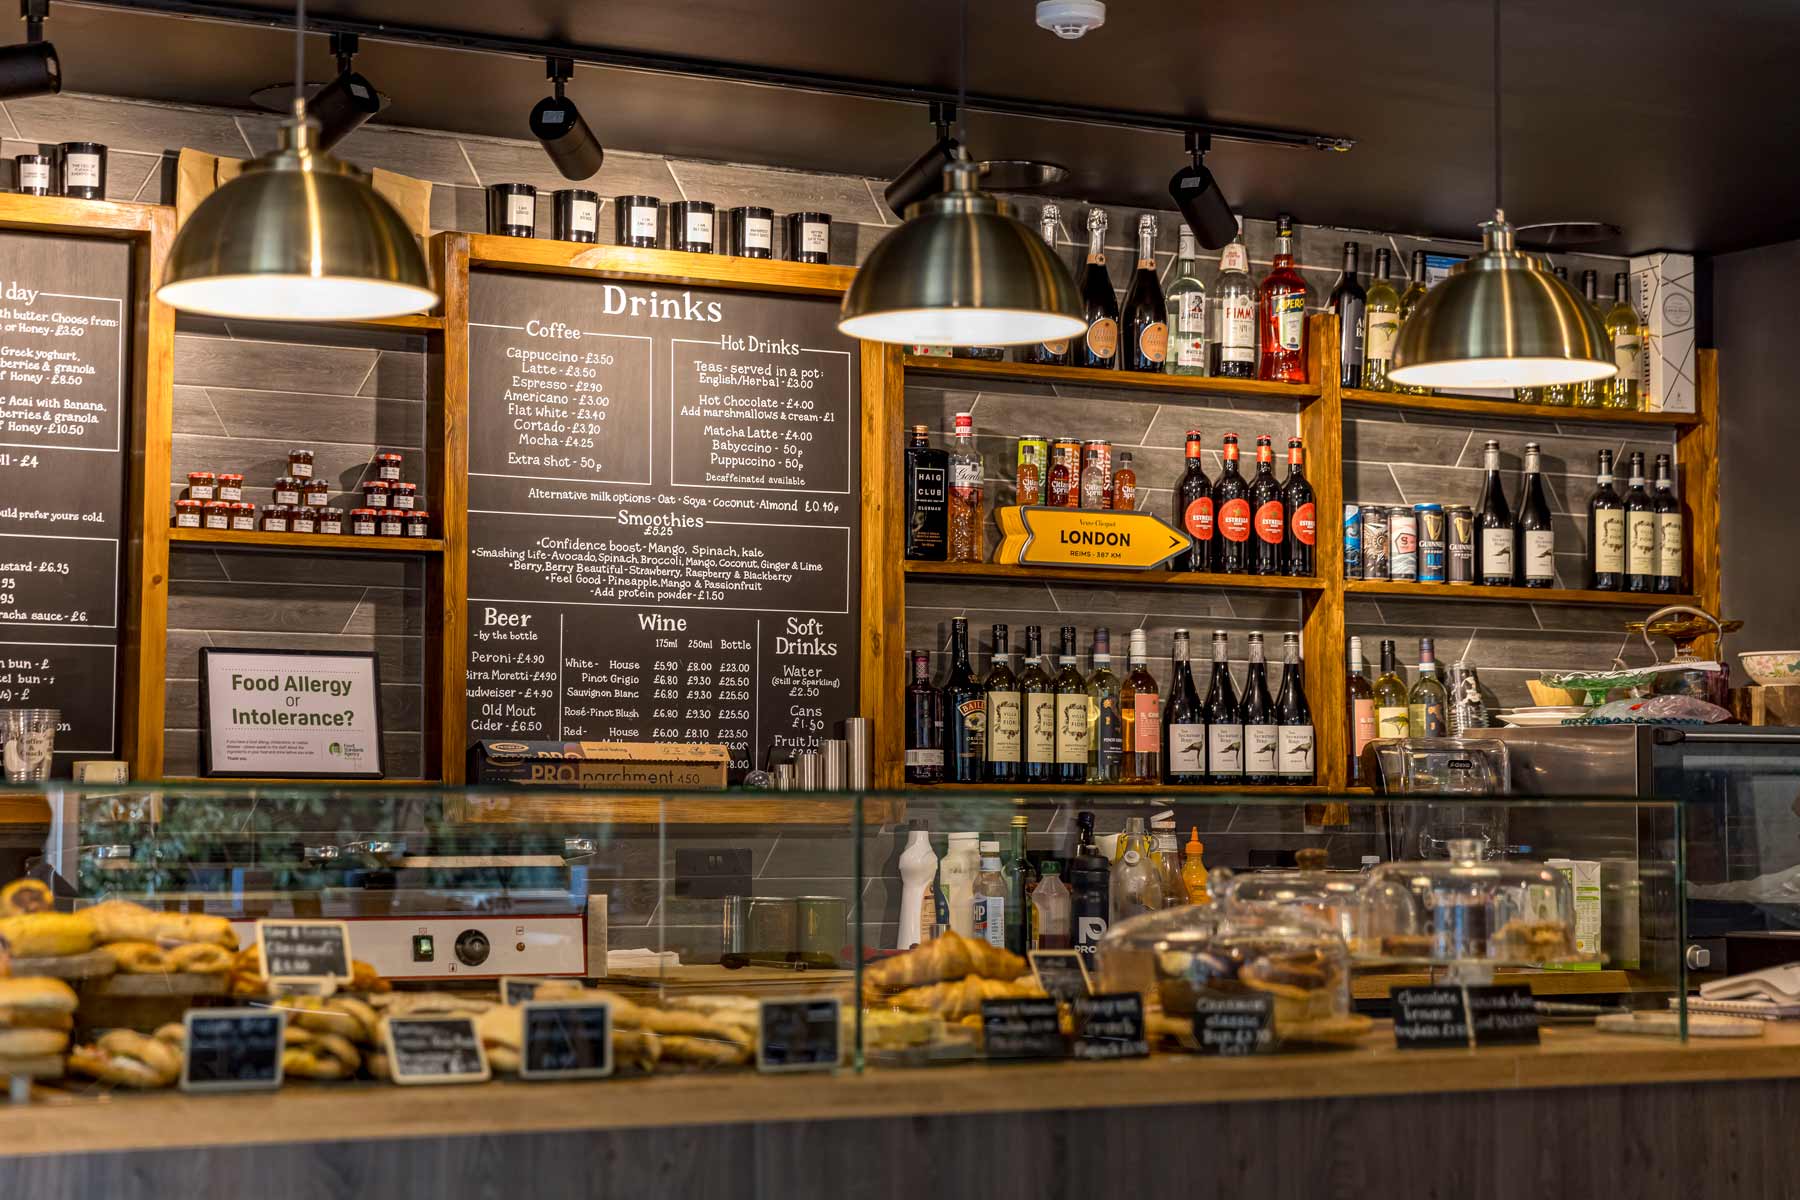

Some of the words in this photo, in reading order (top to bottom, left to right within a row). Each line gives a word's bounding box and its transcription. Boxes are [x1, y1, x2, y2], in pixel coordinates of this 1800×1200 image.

[6, 281, 38, 306] day
[602, 285, 722, 322] Drinks
[52, 313, 88, 325] Choose
[19, 323, 50, 336] Honey
[526, 320, 582, 340] Coffee
[1, 346, 33, 357] Greek
[721, 335, 745, 351] Hot
[748, 336, 800, 356] Drinks
[506, 348, 578, 362] Cappuccino
[522, 362, 556, 375] Latte
[694, 360, 722, 373] Teas
[731, 364, 772, 376] served
[776, 366, 786, 377] in
[512, 376, 567, 392] Espresso
[700, 372, 780, 388] English/Herbal
[9, 396, 32, 406] Acai
[36, 398, 60, 408] with
[504, 390, 568, 404] Americano
[699, 395, 720, 406] Hot
[724, 396, 778, 408] Chocolate
[508, 403, 532, 416] Flat
[680, 406, 700, 416] Add
[704, 408, 778, 420] marshmallows
[780, 412, 787, 420] &
[514, 419, 565, 432] Cortado
[704, 426, 745, 437] Matcha
[748, 426, 778, 439] Latte
[518, 434, 558, 446] Mocha
[712, 440, 772, 454] Babyccino
[508, 452, 540, 466] Extra
[544, 454, 570, 468] shot
[711, 453, 776, 468] Puppuccino
[706, 472, 764, 484] Decaffeinated
[768, 476, 806, 486] available
[918, 473, 942, 482] HAIG
[918, 488, 942, 496] CLUB
[19, 510, 50, 520] prefer
[50, 512, 79, 522] yours
[618, 510, 704, 528] Smoothies
[1060, 530, 1130, 547] LONDON
[542, 538, 606, 551] Confidence
[610, 540, 640, 553] boost
[476, 548, 525, 562] Smashing
[761, 560, 790, 571] Ginger
[792, 562, 798, 570] &
[800, 562, 823, 571] Lime
[550, 574, 572, 584] Feel
[576, 574, 600, 584] Good
[694, 580, 702, 588] &
[484, 608, 532, 626] Beer
[638, 614, 687, 632] Wine
[786, 616, 824, 636] Soft
[492, 630, 508, 640] the
[510, 631, 538, 640] bottle
[656, 639, 678, 648] 175ml
[688, 640, 712, 648] 250ml
[776, 637, 838, 656] Drinks
[472, 652, 512, 664] Peroni
[610, 660, 640, 670] House
[783, 665, 822, 677] Water
[232, 675, 279, 691] Food
[284, 676, 352, 696] Allergy
[582, 673, 608, 684] Pinot
[610, 675, 640, 686] Grigio
[567, 688, 612, 698] Sauvignon
[614, 689, 639, 698] Blanc
[286, 696, 300, 706] or
[482, 704, 502, 716] Old
[506, 704, 536, 716] Mout
[790, 705, 822, 717] Cans
[232, 708, 354, 726] Intolerance?
[471, 720, 502, 731] Cider
[610, 728, 639, 737] House
[774, 735, 804, 748] Fruit
[532, 764, 575, 781] PRO
[584, 766, 674, 788] parchment
[678, 774, 700, 784] 450
[1074, 944, 1097, 953] PRO
